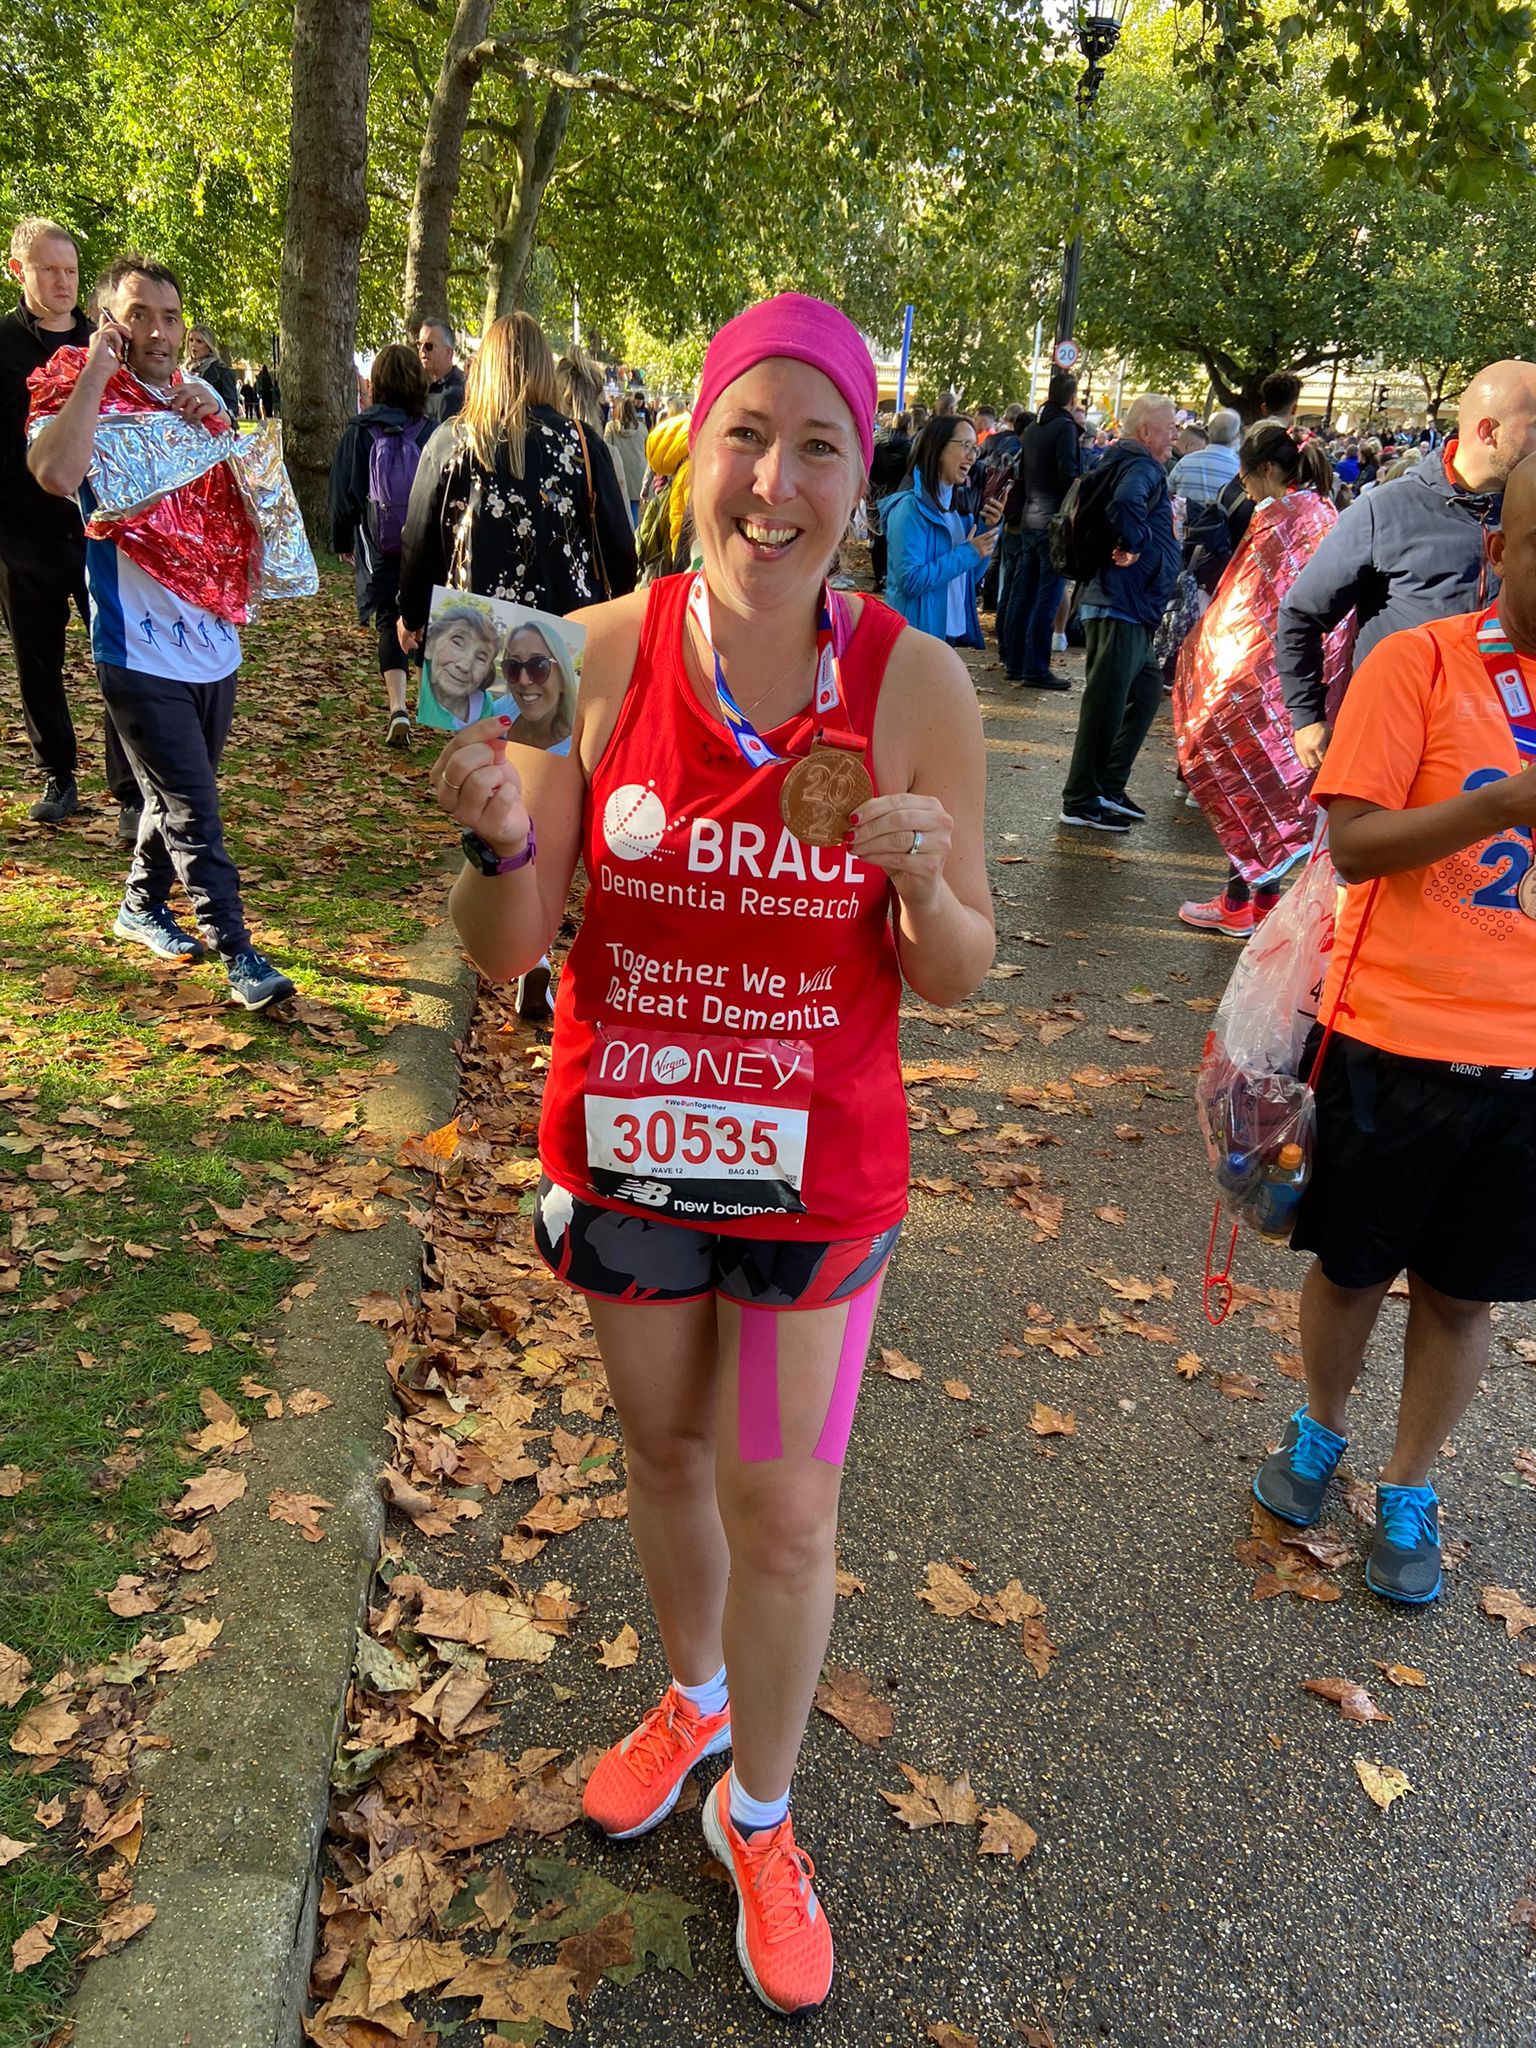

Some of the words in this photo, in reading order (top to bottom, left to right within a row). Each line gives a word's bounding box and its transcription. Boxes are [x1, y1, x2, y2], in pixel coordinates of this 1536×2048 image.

[1059, 349, 1076, 361] 20
[801, 762, 854, 807] 20
[688, 817, 865, 884] BRACE
[600, 864, 726, 912] Dementia
[740, 886, 860, 920] Research
[605, 942, 730, 988] Together
[741, 962, 787, 999] We
[604, 976, 689, 1020] Defeat
[702, 994, 841, 1032] Dementia
[654, 1050, 688, 1080] Virgin
[1450, 1062, 1483, 1077] EVENTS
[612, 1109, 779, 1166] 30535
[650, 1166, 674, 1175] WAVE
[675, 1166, 684, 1175] 12
[728, 1168, 745, 1176] BAG
[746, 1168, 760, 1176] 433
[674, 1199, 709, 1214] new
